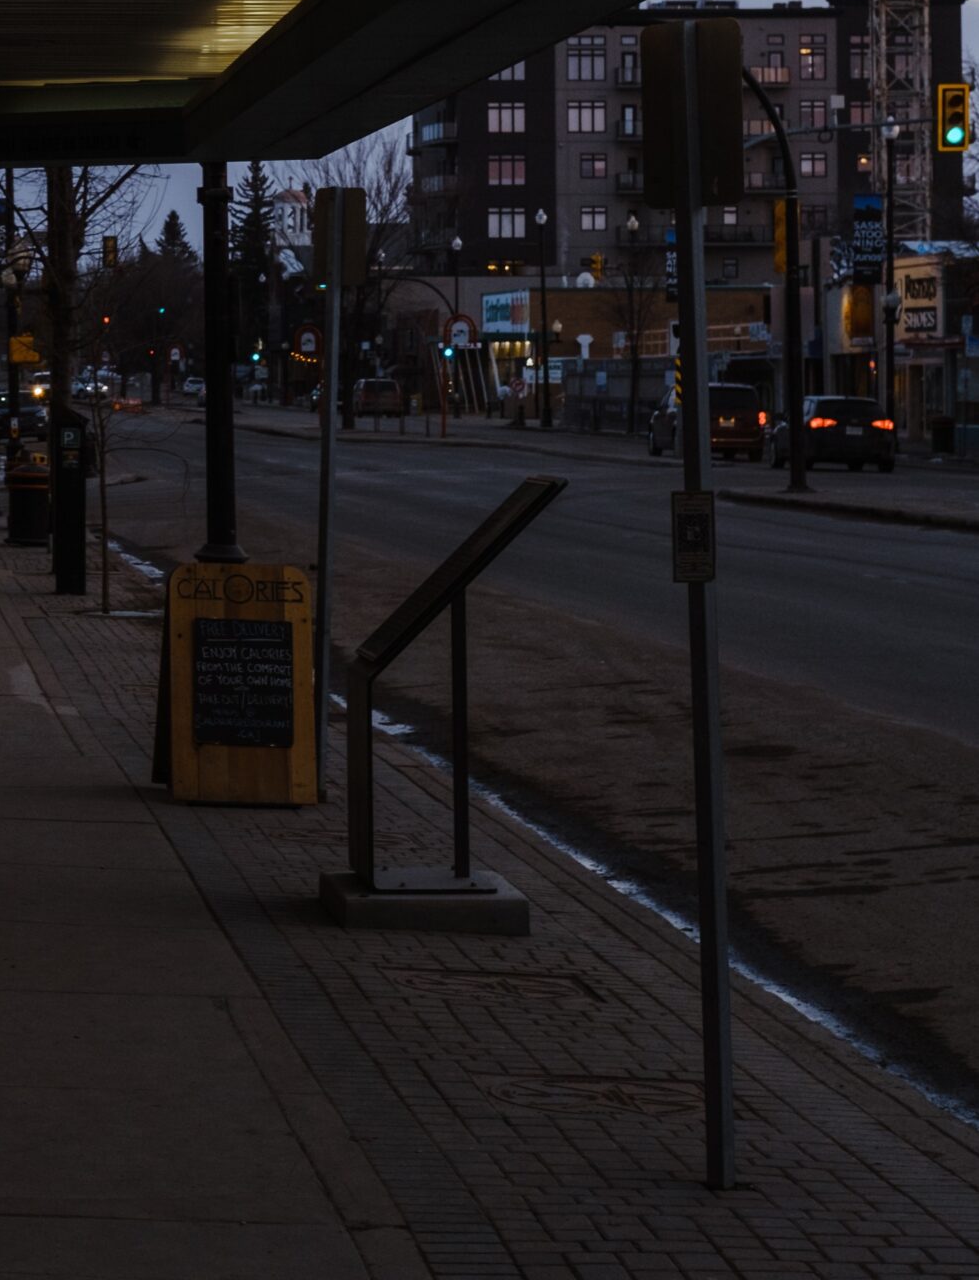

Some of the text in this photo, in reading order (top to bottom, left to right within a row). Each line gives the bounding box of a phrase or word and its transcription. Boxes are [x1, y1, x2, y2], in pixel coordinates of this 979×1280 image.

[903, 311, 935, 328] SHOES
[64, 431, 75, 445] P
[177, 573, 304, 605] CALORIES
[202, 646, 292, 661] ENJOY CALORIES
[224, 662, 244, 673] THE
[198, 674, 213, 686] OF
[215, 673, 244, 686] YOUR
[246, 674, 269, 687] OWN
